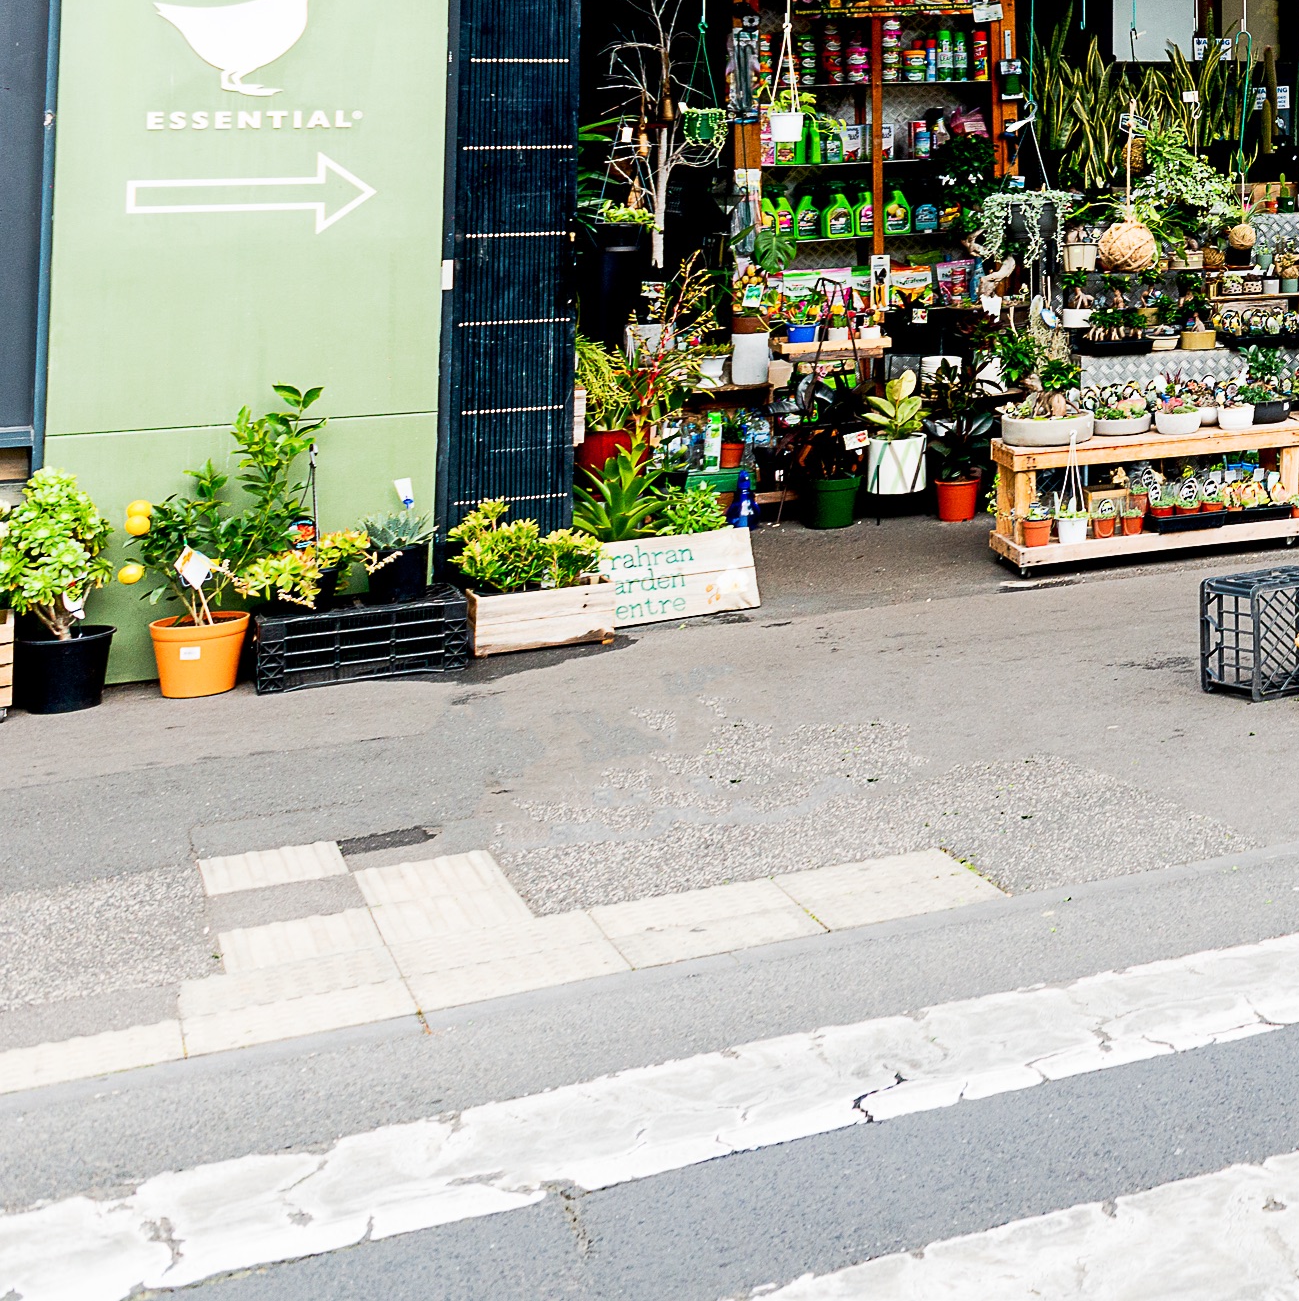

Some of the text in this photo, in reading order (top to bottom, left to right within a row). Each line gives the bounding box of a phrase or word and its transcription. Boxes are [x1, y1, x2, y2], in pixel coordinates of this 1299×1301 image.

[823, 7, 849, 15] Growing
[888, 4, 919, 12] Protection
[604, 568, 686, 596] arden
[615, 597, 686, 620] entre
